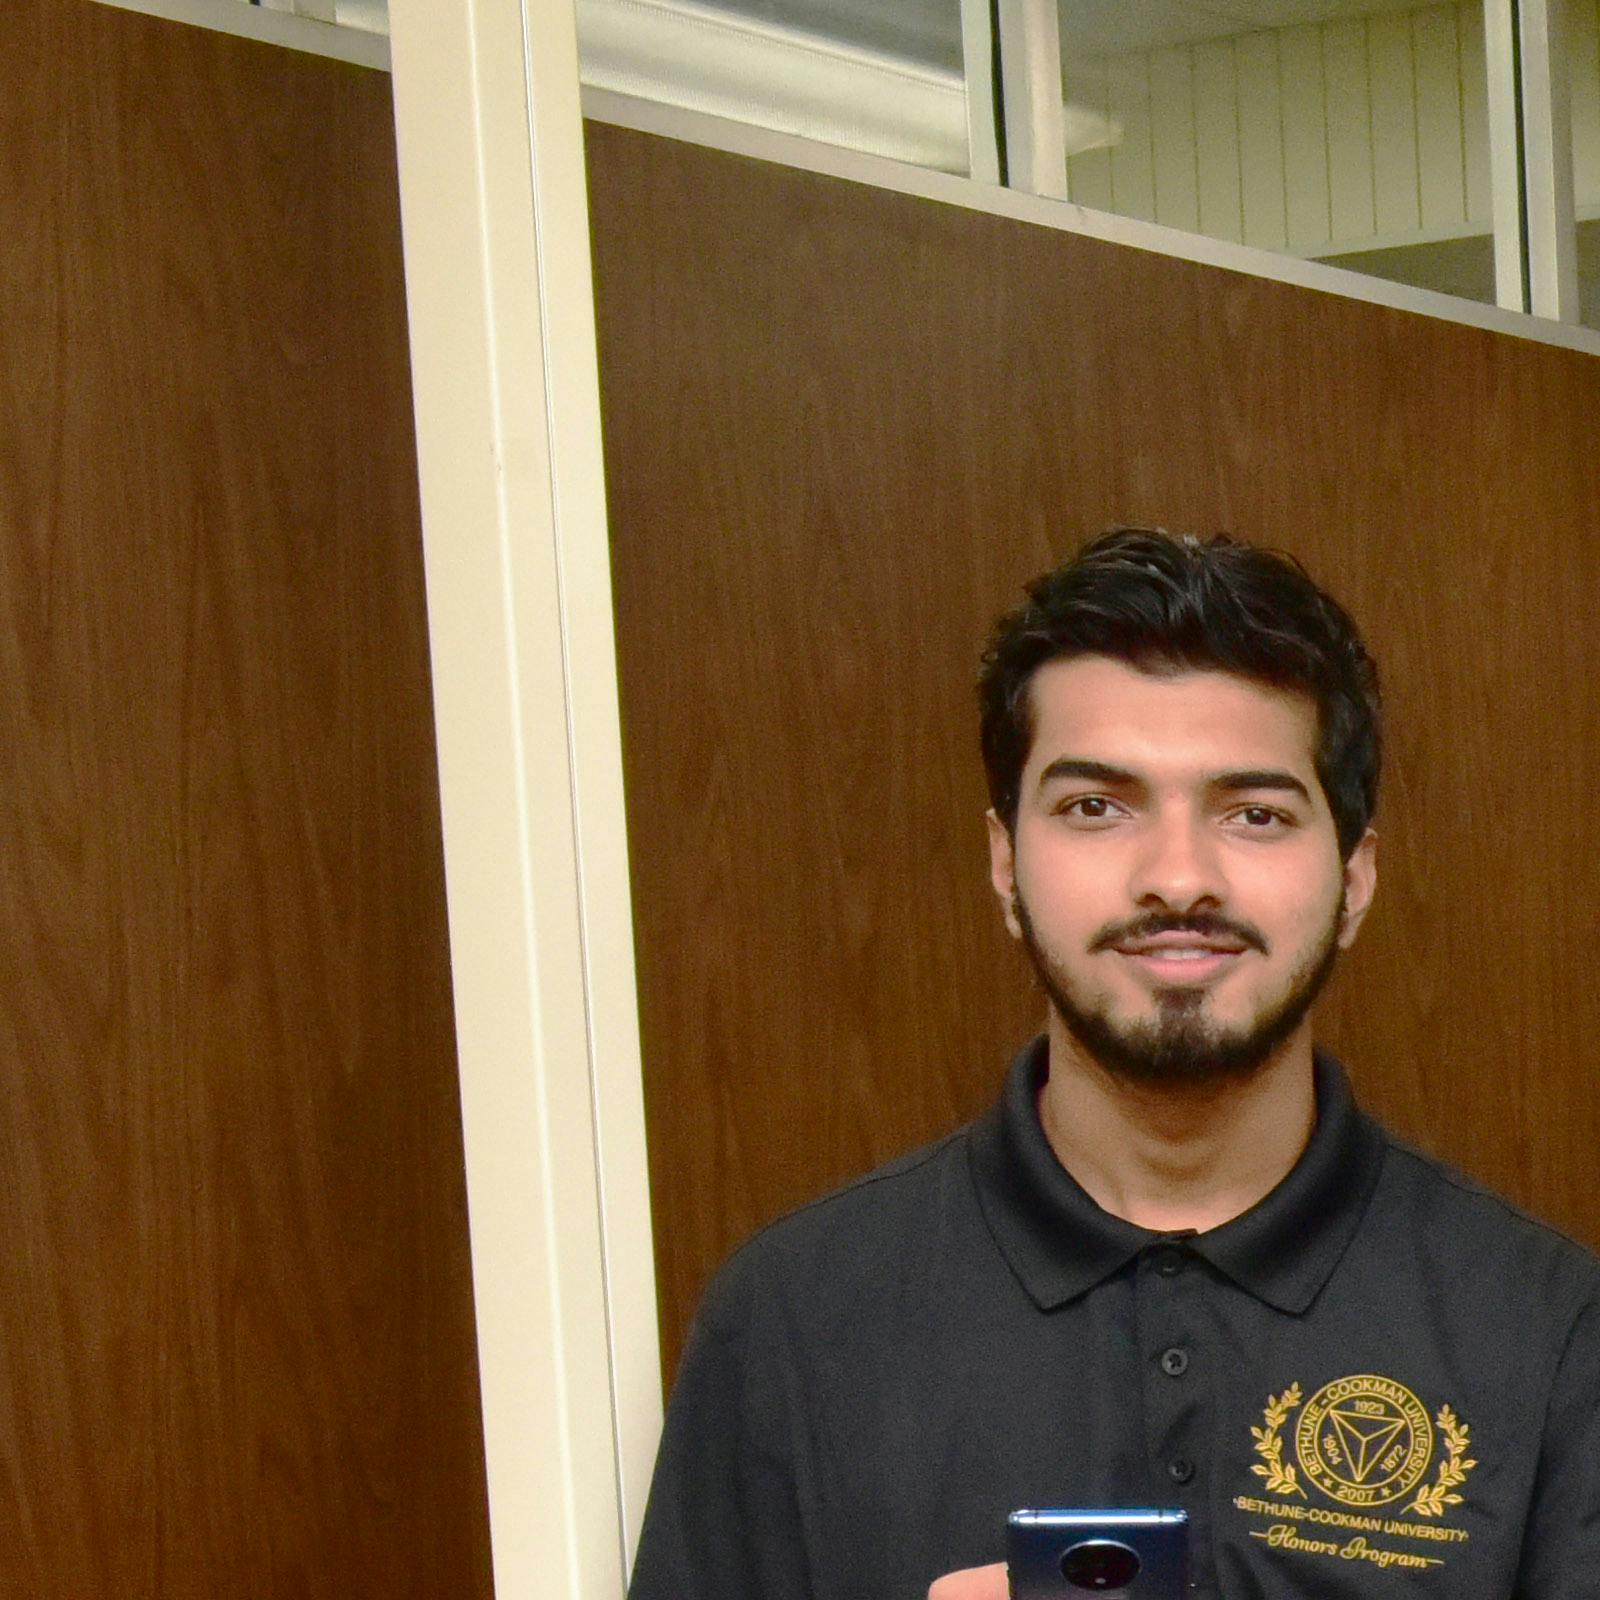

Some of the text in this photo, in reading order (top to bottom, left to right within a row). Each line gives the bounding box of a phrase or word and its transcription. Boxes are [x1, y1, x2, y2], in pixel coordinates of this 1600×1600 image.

[1354, 1400, 1385, 1416] 1923
[1322, 1433, 1343, 1465] 1904
[1380, 1444, 1408, 1473] 1872
[1398, 1401, 1428, 1489] UNIVERSITY
[1336, 1485, 1376, 1502] 2007
[1237, 1495, 1466, 1542] BETHUNE-COOKMAN UNIVERSITY
[1266, 1524, 1429, 1569] Honors Program
